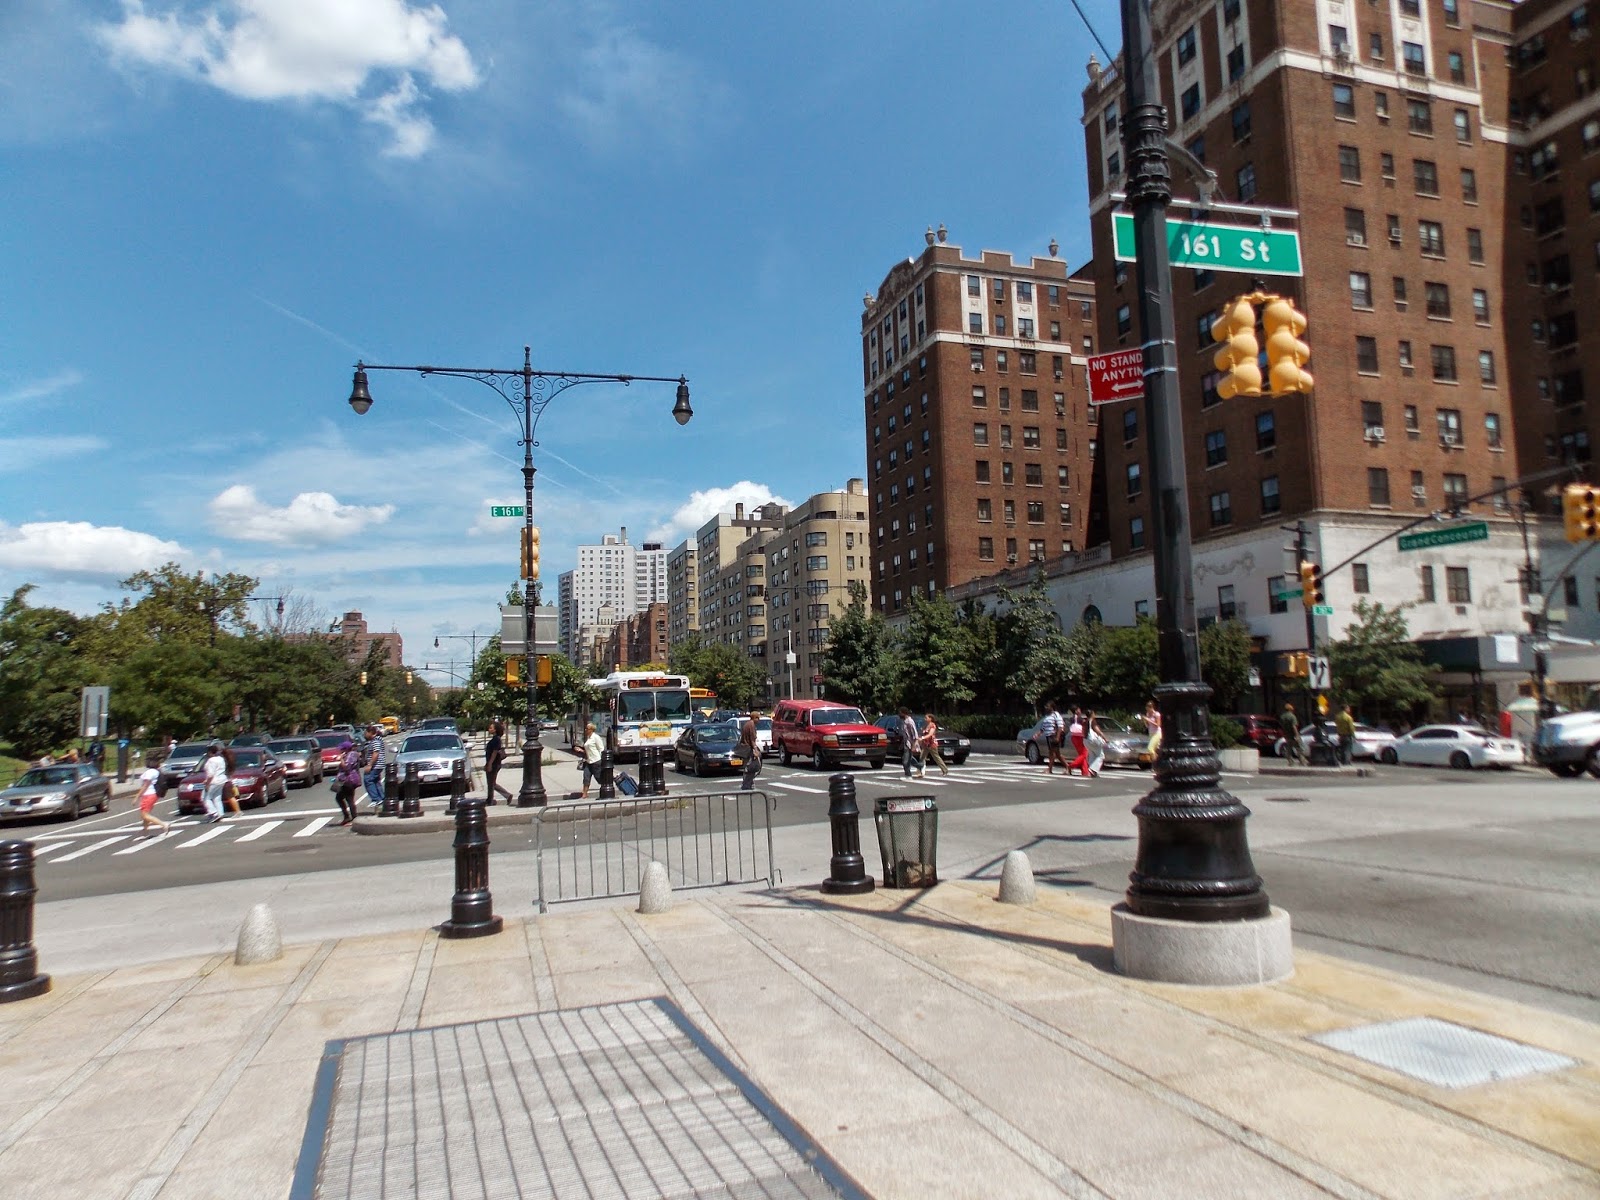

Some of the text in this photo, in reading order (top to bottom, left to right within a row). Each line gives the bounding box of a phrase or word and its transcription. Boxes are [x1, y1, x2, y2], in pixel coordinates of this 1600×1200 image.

[1181, 233, 1270, 263] 161 St
[1092, 353, 1143, 371] NO STAND
[493, 507, 498, 517] E
[501, 507, 515, 516] 161
[1431, 529, 1484, 544] Concourse
